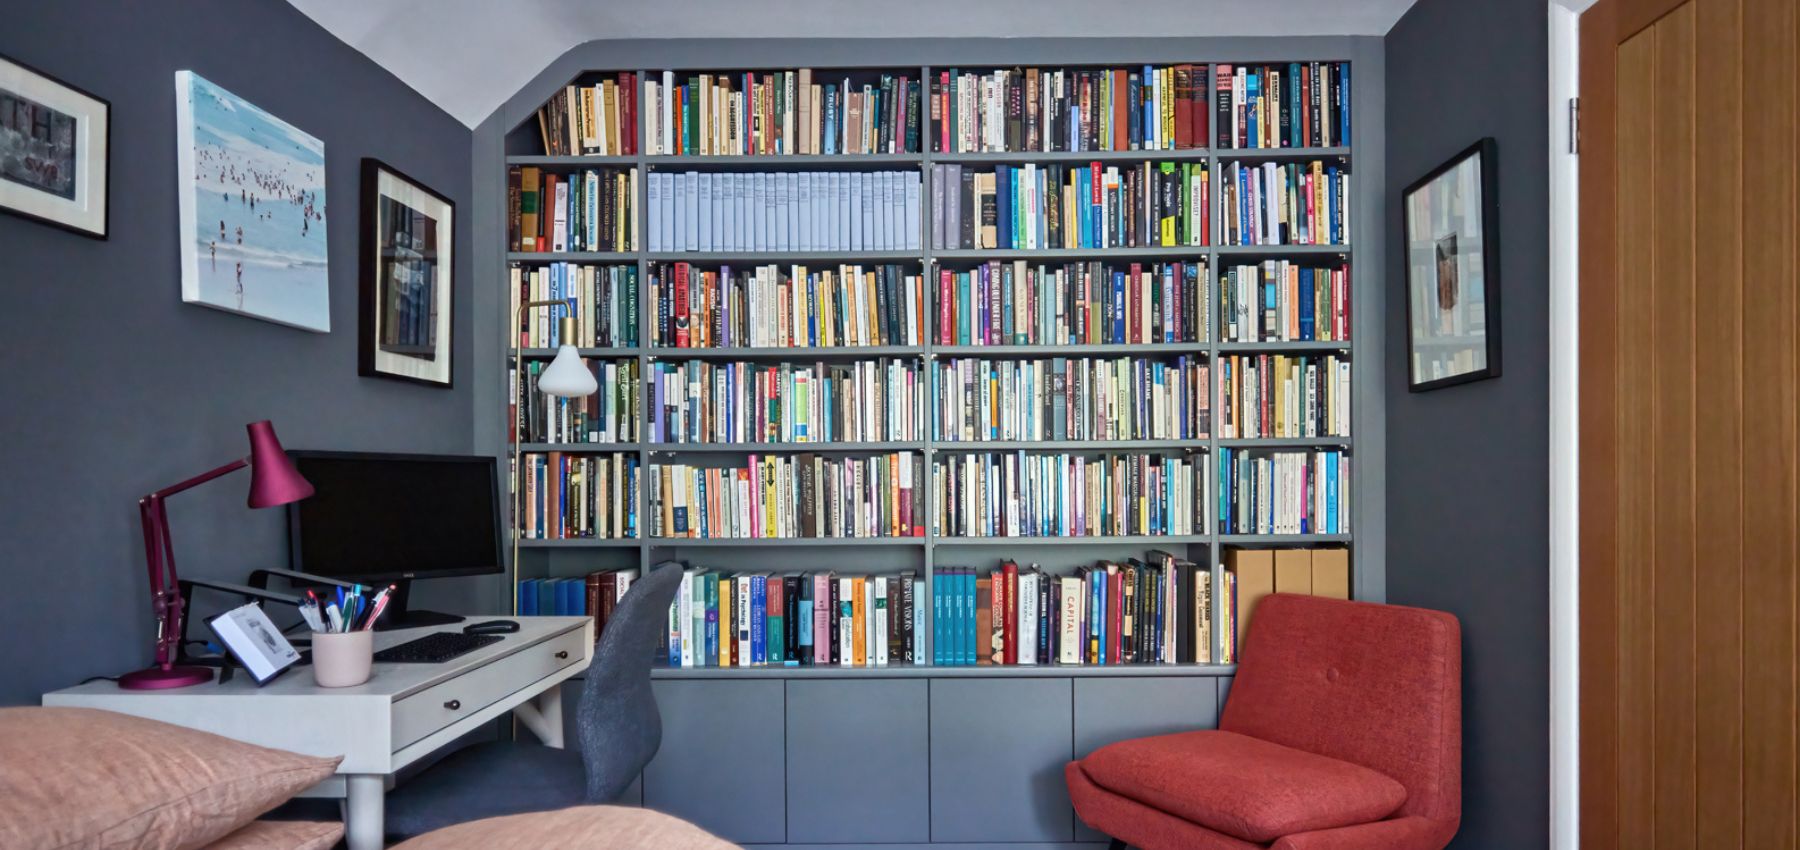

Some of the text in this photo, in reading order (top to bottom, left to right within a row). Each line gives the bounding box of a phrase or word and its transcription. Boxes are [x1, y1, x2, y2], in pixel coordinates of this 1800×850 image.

[992, 269, 1000, 287] COMING
[992, 301, 1000, 317] UNDER
[992, 319, 1000, 329] FIRE
[740, 600, 748, 626] Psychology
[904, 606, 912, 630] VISIONS
